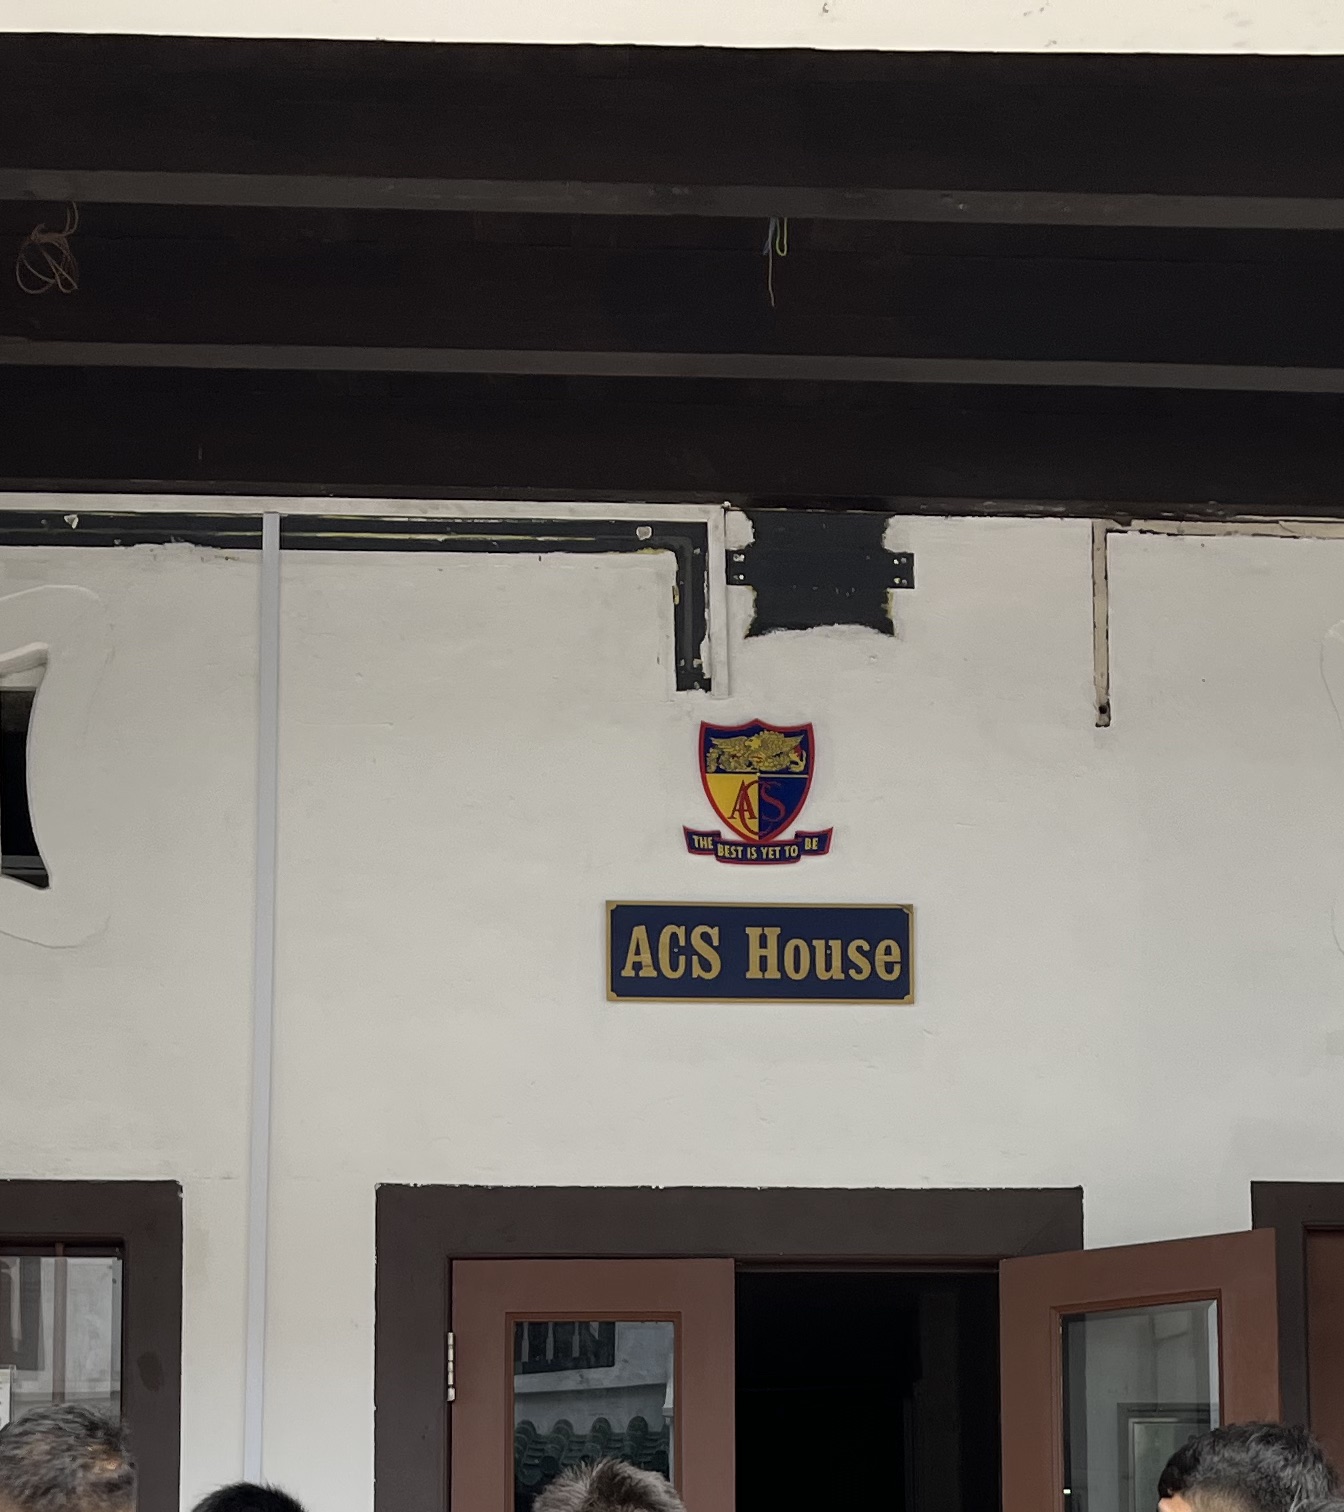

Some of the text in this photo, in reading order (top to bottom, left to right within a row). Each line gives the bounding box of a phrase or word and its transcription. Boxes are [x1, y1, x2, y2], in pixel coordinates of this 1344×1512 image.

[692, 835, 819, 859] THE BEST IS YET TO BE
[620, 924, 901, 981] ACS House
